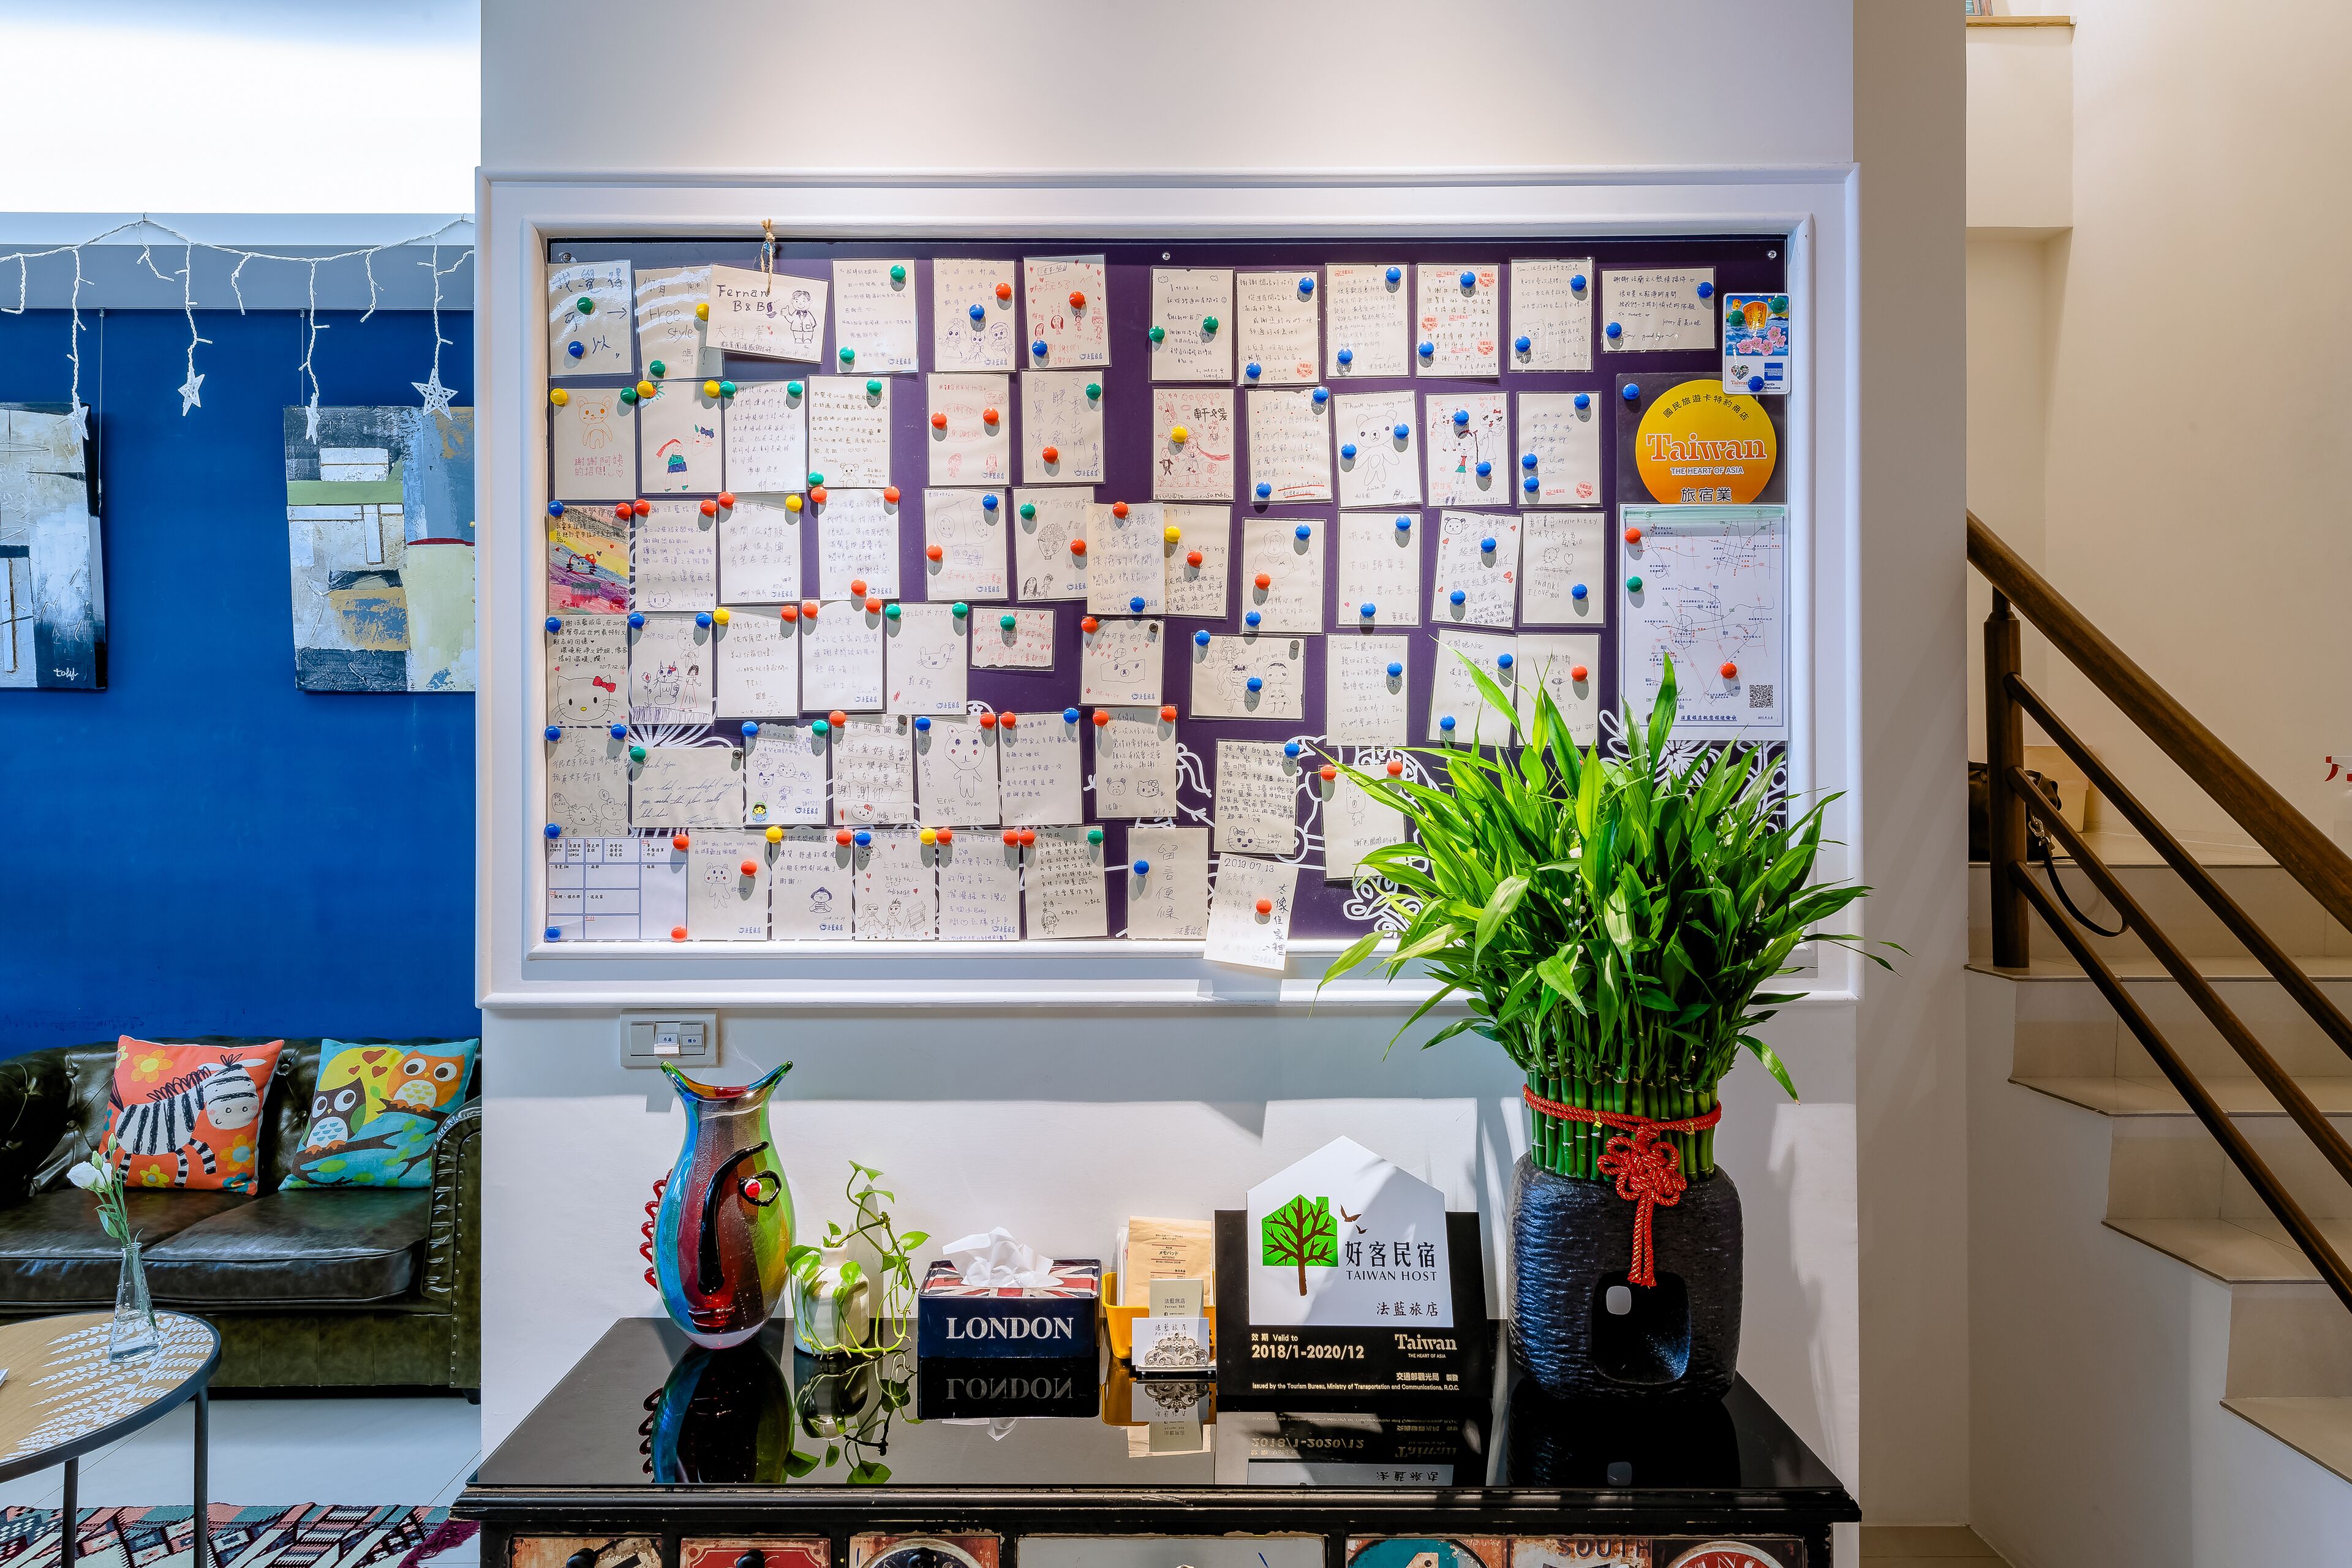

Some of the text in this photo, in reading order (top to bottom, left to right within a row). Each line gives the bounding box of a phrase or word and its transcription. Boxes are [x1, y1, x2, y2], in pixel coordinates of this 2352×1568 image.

[649, 305, 680, 322] Free
[1662, 393, 1750, 422] 國民旅遊卡特約商店
[1646, 432, 1768, 461] Taiwan
[1681, 488, 1733, 503] 旅宿業
[692, 588, 708, 599] Tong
[1094, 592, 1114, 601] Thank
[1224, 858, 1275, 873] 2019.07.13
[1155, 843, 1178, 920] 留言便條
[1344, 1240, 1436, 1268] 好客民宿
[1346, 1270, 1437, 1281] TAIWAN HOST
[1376, 1302, 1438, 1317] 法藍旅店
[946, 1317, 1074, 1340] LONDON
[1251, 1333, 1268, 1342] 效期
[1394, 1333, 1457, 1351] Taiwan
[1251, 1344, 1364, 1360] 2018/1-2020/12
[1396, 1372, 1439, 1382] 交通部觀光局
